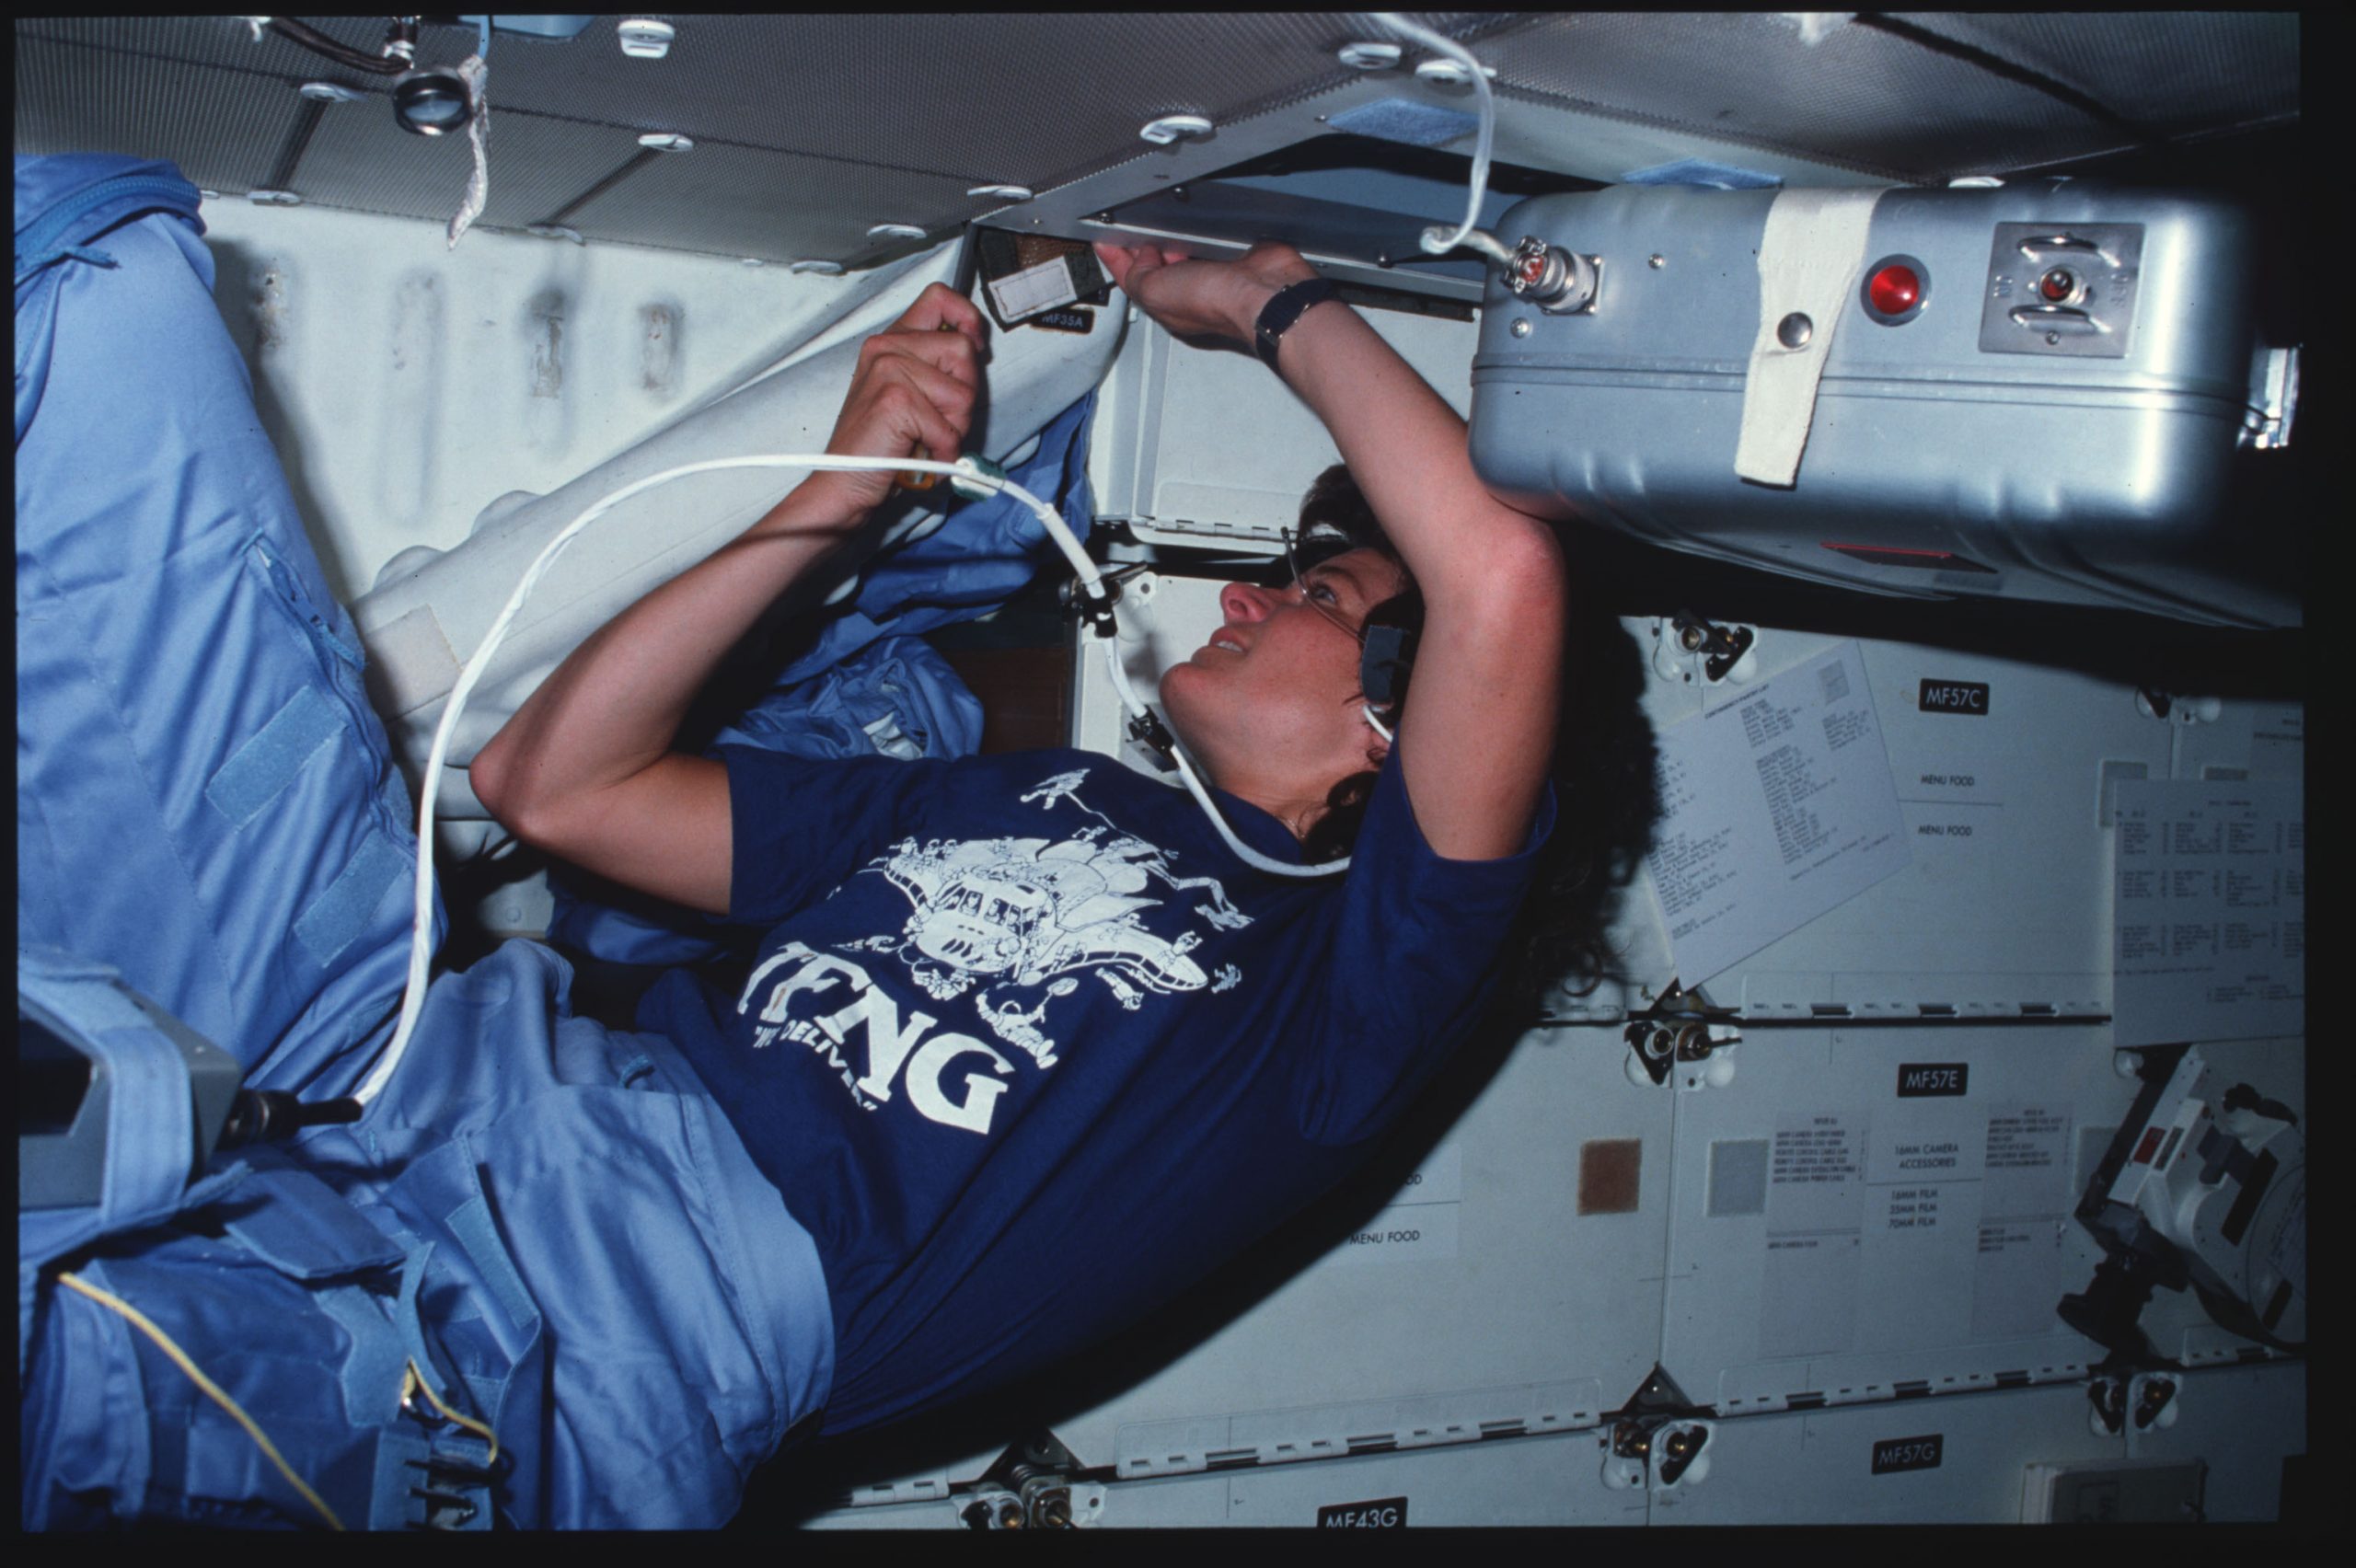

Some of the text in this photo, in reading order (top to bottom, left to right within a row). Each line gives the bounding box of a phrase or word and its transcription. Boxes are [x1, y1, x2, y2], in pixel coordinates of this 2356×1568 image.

[1042, 314, 1083, 328] MF35A
[1925, 686, 1981, 708] MF57C
[1921, 774, 1976, 787] MENU FOOD
[1918, 824, 1973, 836] MENU FOOD
[1906, 1069, 1958, 1089] MF57E
[1895, 1143, 1959, 1156] 16MM CAMERA
[1899, 1158, 1958, 1170] ACCESSORIES
[1405, 1174, 1423, 1185] OD
[1891, 1189, 1939, 1201] 16MM FILM
[1918, 1203, 1938, 1213] FILM
[1917, 1216, 1937, 1228] FILM
[1349, 1229, 1422, 1245] MENU FOOD
[1878, 1442, 1935, 1466] MF57G
[1326, 1507, 1398, 1528] MF43G
